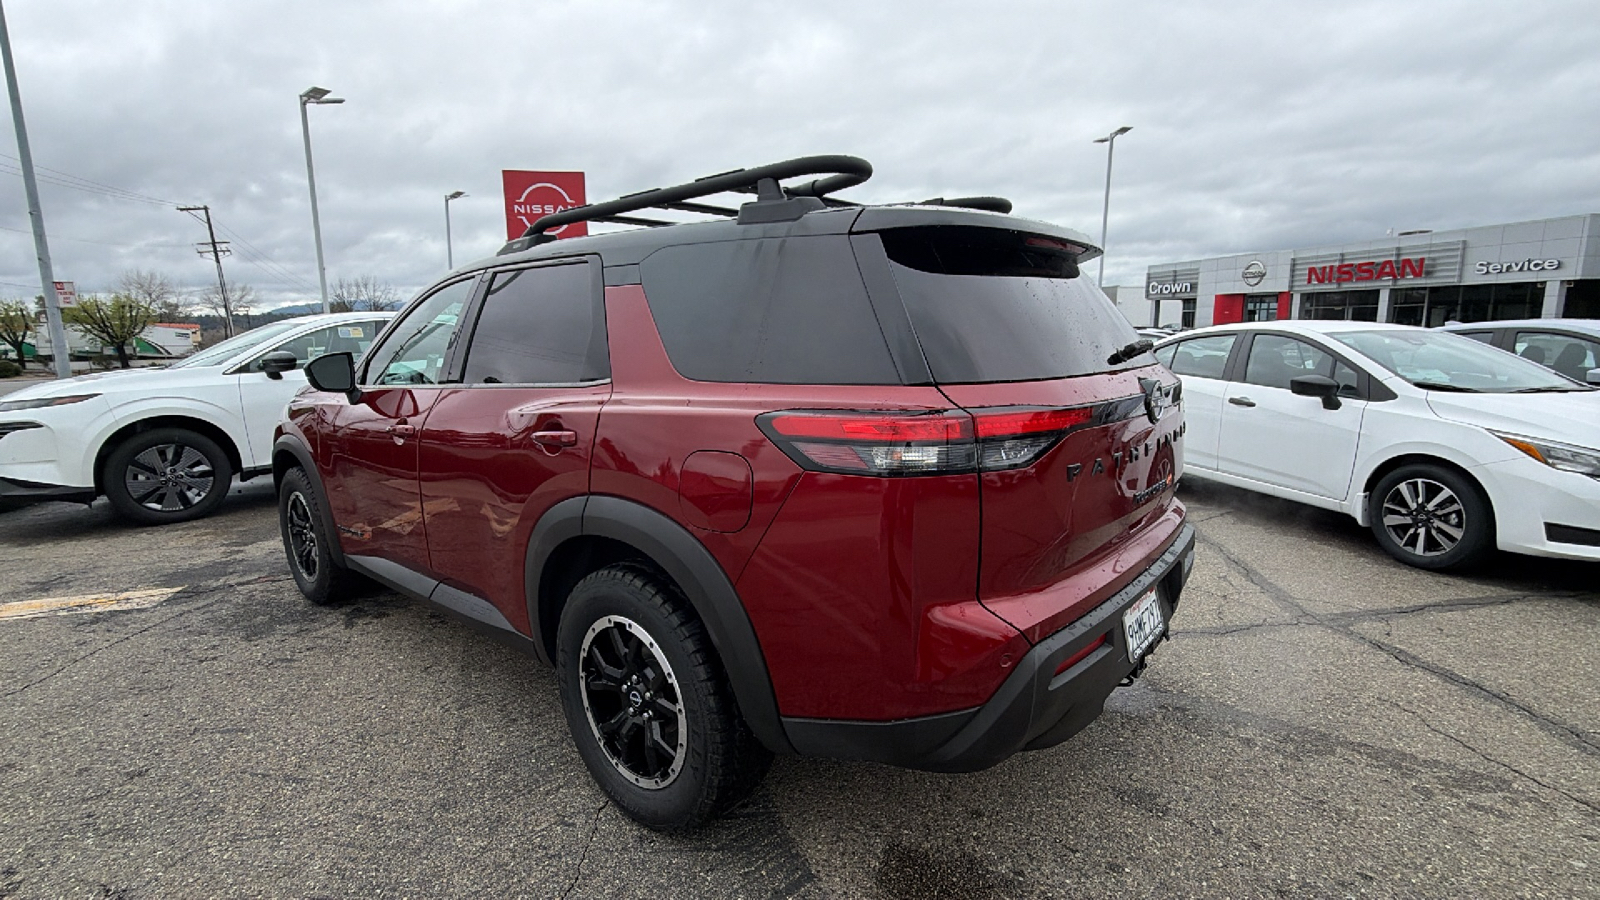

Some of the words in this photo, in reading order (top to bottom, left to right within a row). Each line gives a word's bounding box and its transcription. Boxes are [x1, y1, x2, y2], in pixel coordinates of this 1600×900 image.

[1306, 257, 1426, 285] NISSAN
[1474, 257, 1560, 275] Service
[1149, 281, 1191, 294] Crown
